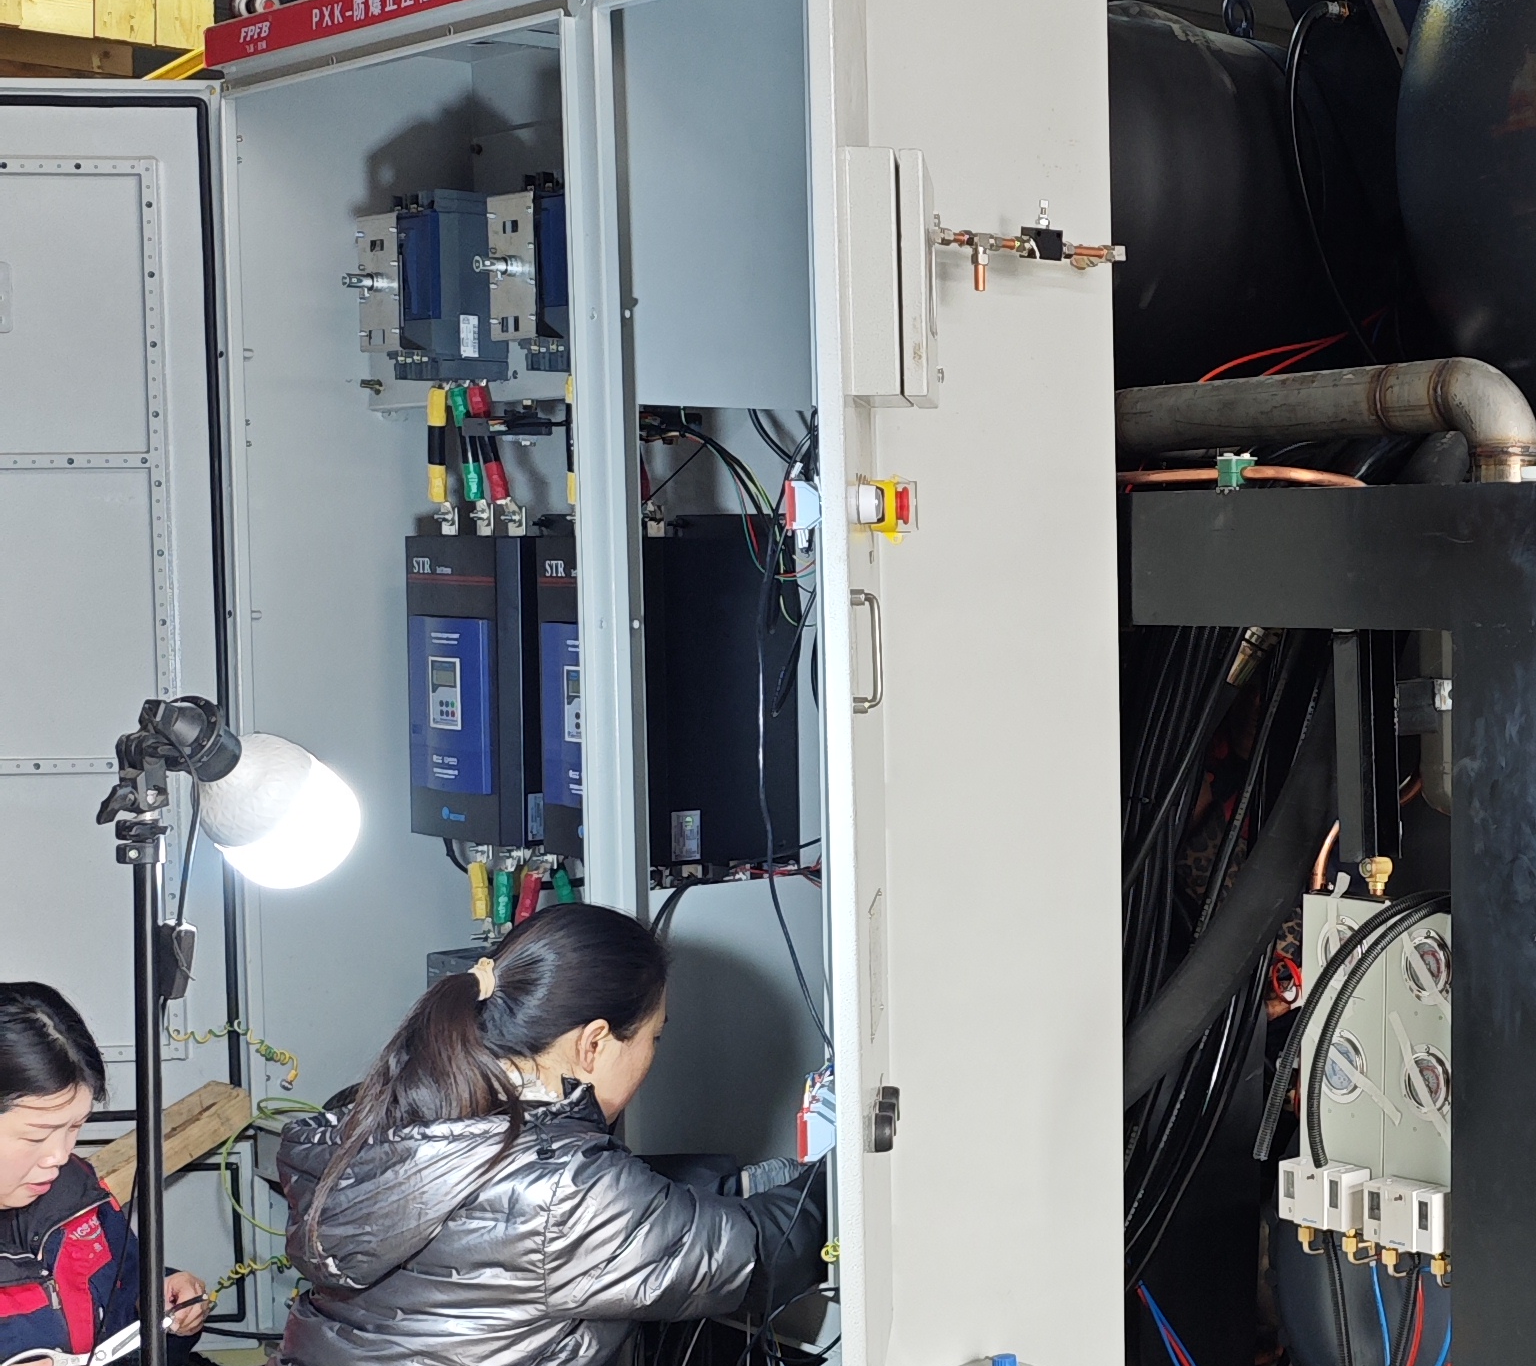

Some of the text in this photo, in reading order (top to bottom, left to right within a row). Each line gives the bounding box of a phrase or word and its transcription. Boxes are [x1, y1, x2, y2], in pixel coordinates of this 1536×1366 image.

[239, 21, 270, 43] FPFB
[413, 557, 431, 573] STR
[545, 560, 566, 577] STR
